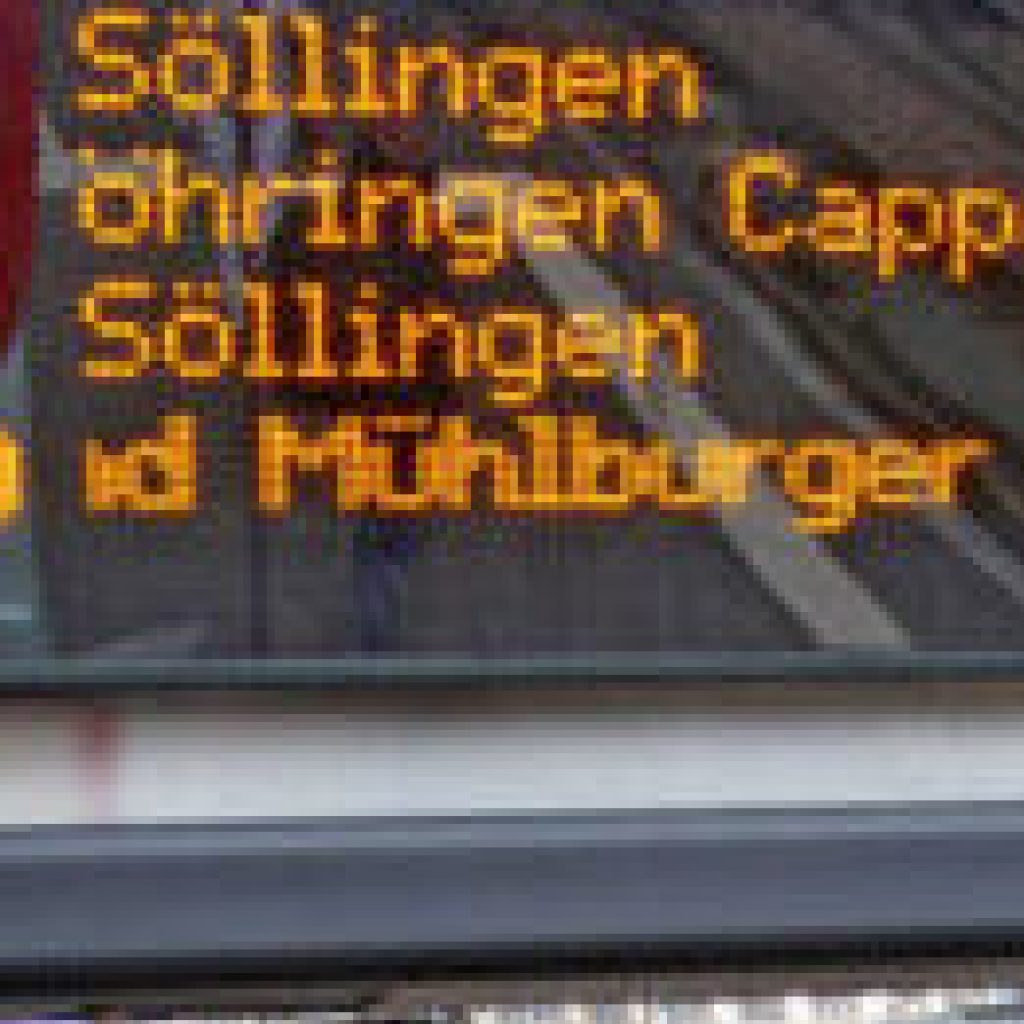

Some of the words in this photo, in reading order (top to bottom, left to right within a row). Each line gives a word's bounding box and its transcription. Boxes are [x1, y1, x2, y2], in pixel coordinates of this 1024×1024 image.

[78, 8, 702, 144] Söllingen
[78, 277, 702, 406] Söllingen
[257, 413, 992, 534] Mühlburger
